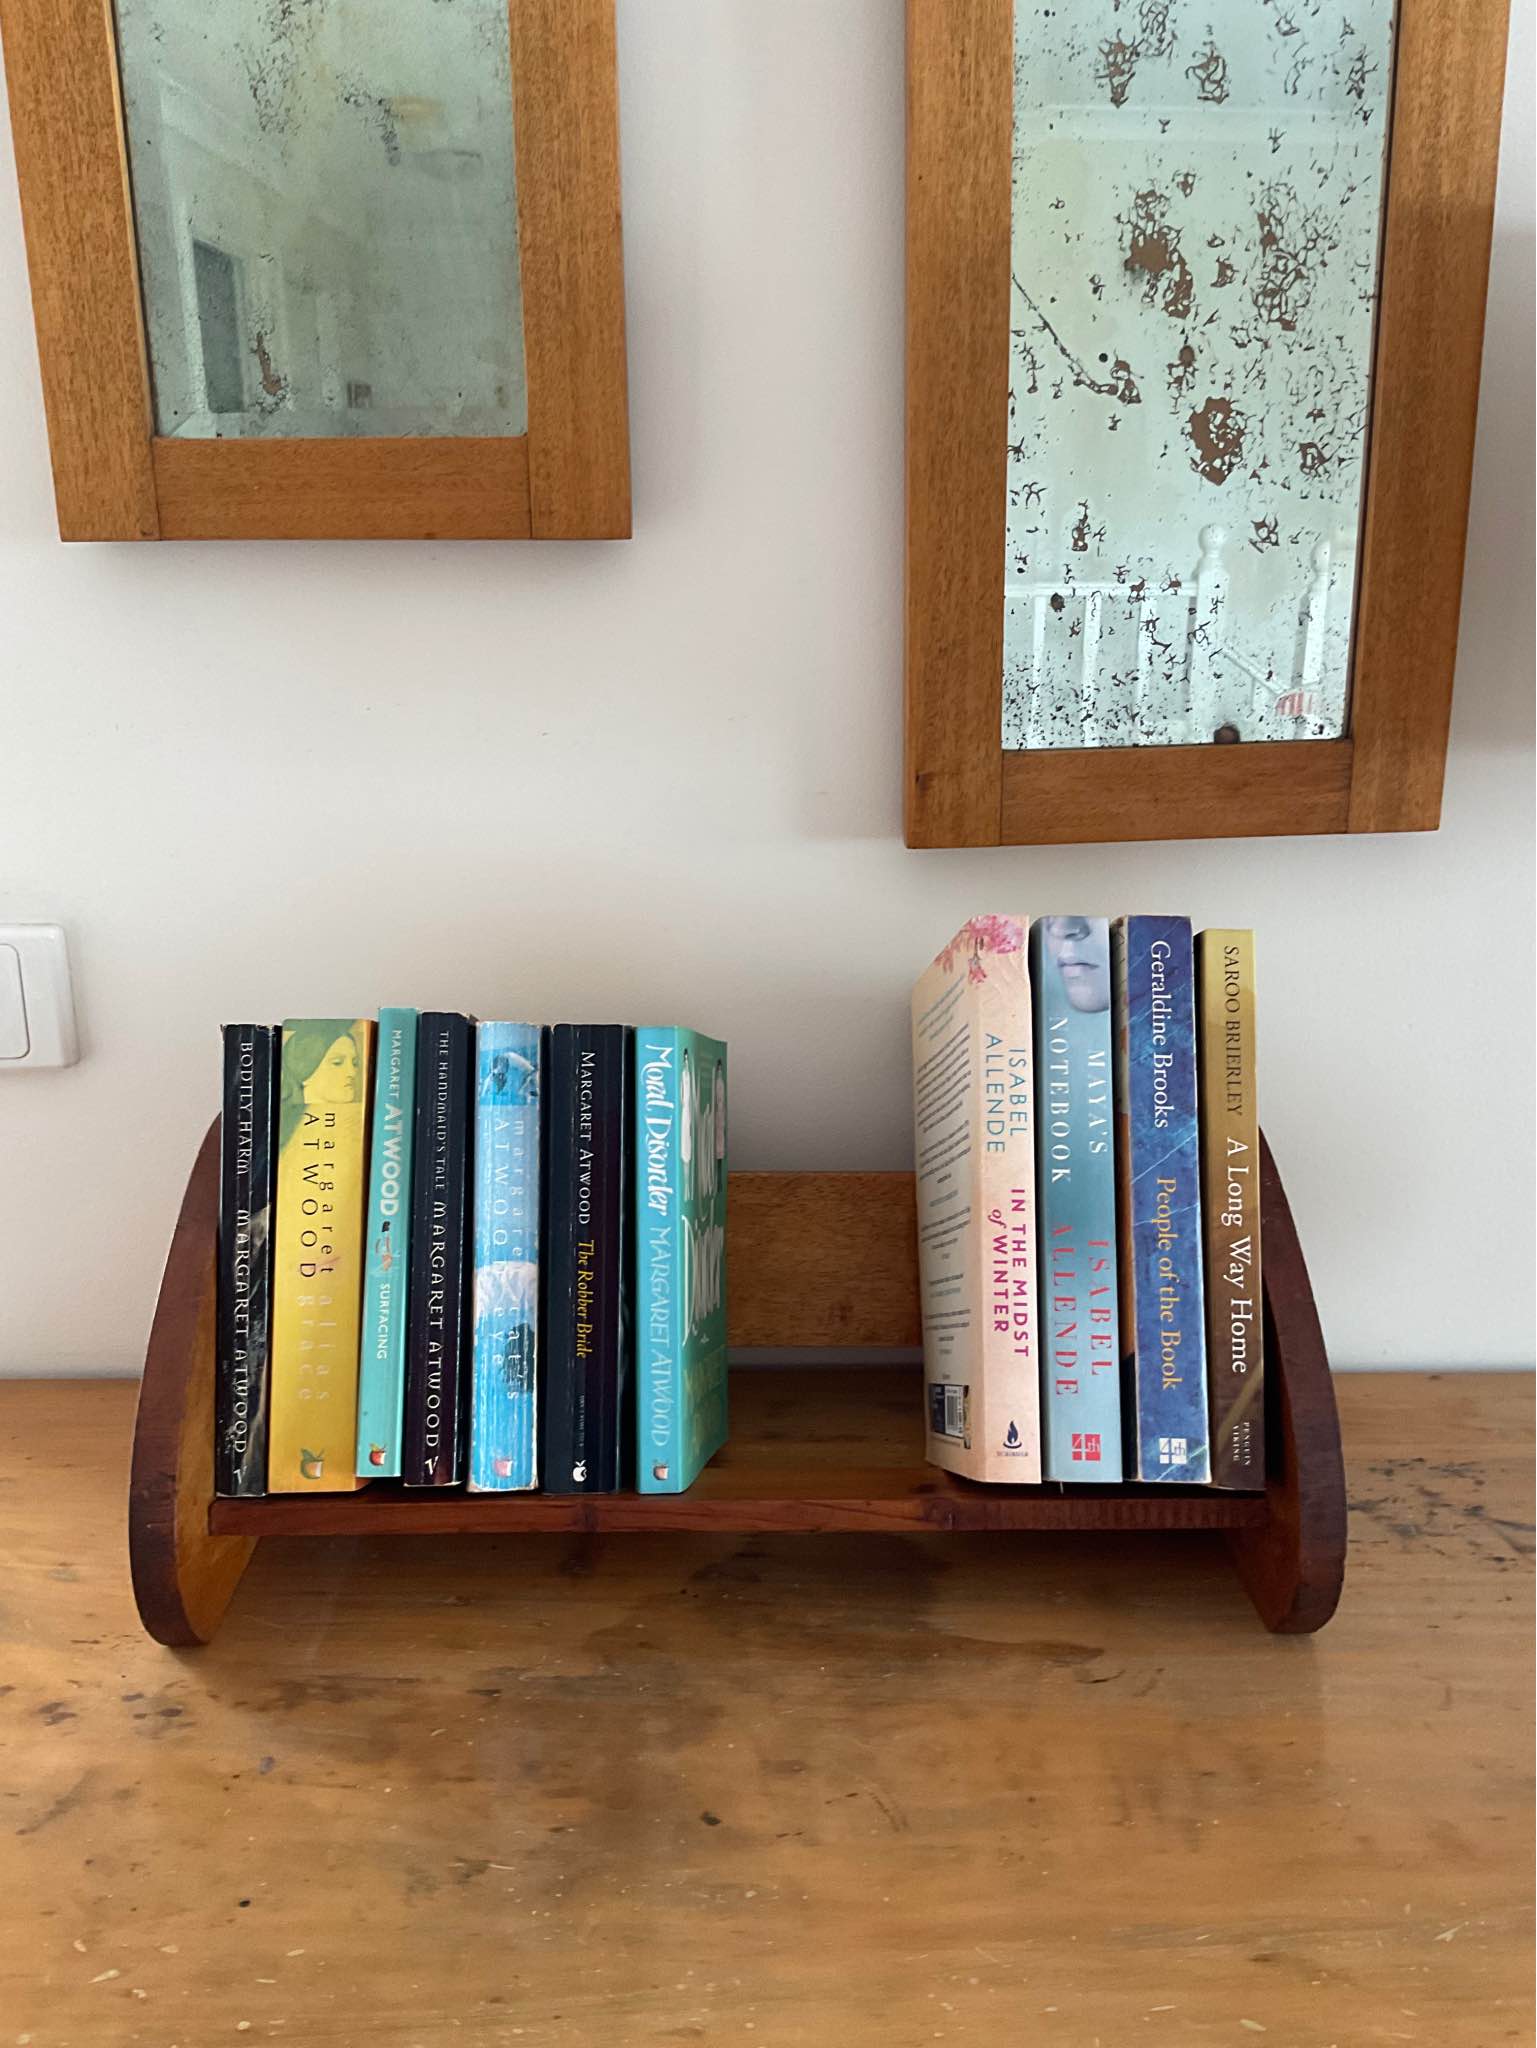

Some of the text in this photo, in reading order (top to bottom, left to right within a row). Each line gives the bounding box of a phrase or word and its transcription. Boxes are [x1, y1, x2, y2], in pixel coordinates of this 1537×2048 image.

[236, 1042, 253, 1175] BODILY HARM
[391, 1030, 402, 1098] MARGARET
[434, 1031, 449, 1190] THE HANDMAID'S TALE
[985, 1033, 1005, 1152] ALLENDE
[1009, 1049, 1027, 1136] ISABEL
[1050, 1016, 1072, 1183] NOTEBOOK
[1088, 1050, 1108, 1154] MAYA'S
[1151, 940, 1174, 1128] Geraldine Brooks
[1224, 946, 1243, 1116] SAROO BRIERLEY
[300, 1113, 320, 1277] ATWOOD
[319, 1113, 336, 1273] margaret
[380, 1103, 403, 1216] ATWOOD
[578, 1051, 596, 1225] MARGARET ATWOOD
[641, 1044, 675, 1216] Moral Disorder
[233, 1209, 249, 1453] MARGARET ATWOOD
[377, 1283, 391, 1360] SURFACING
[426, 1202, 447, 1447] MARGARET ATWOOD
[576, 1240, 595, 1359] The Robber Bride
[649, 1227, 675, 1447] MARGARET ATWOOD
[988, 1209, 1009, 1332] of WINTER
[1011, 1189, 1029, 1357] IN THE MIDST
[1052, 1221, 1078, 1395] ALLENDE
[1088, 1240, 1112, 1376] ISABEL
[1152, 1178, 1183, 1390] People of the Book
[1221, 1137, 1252, 1374] A Long Way Home
